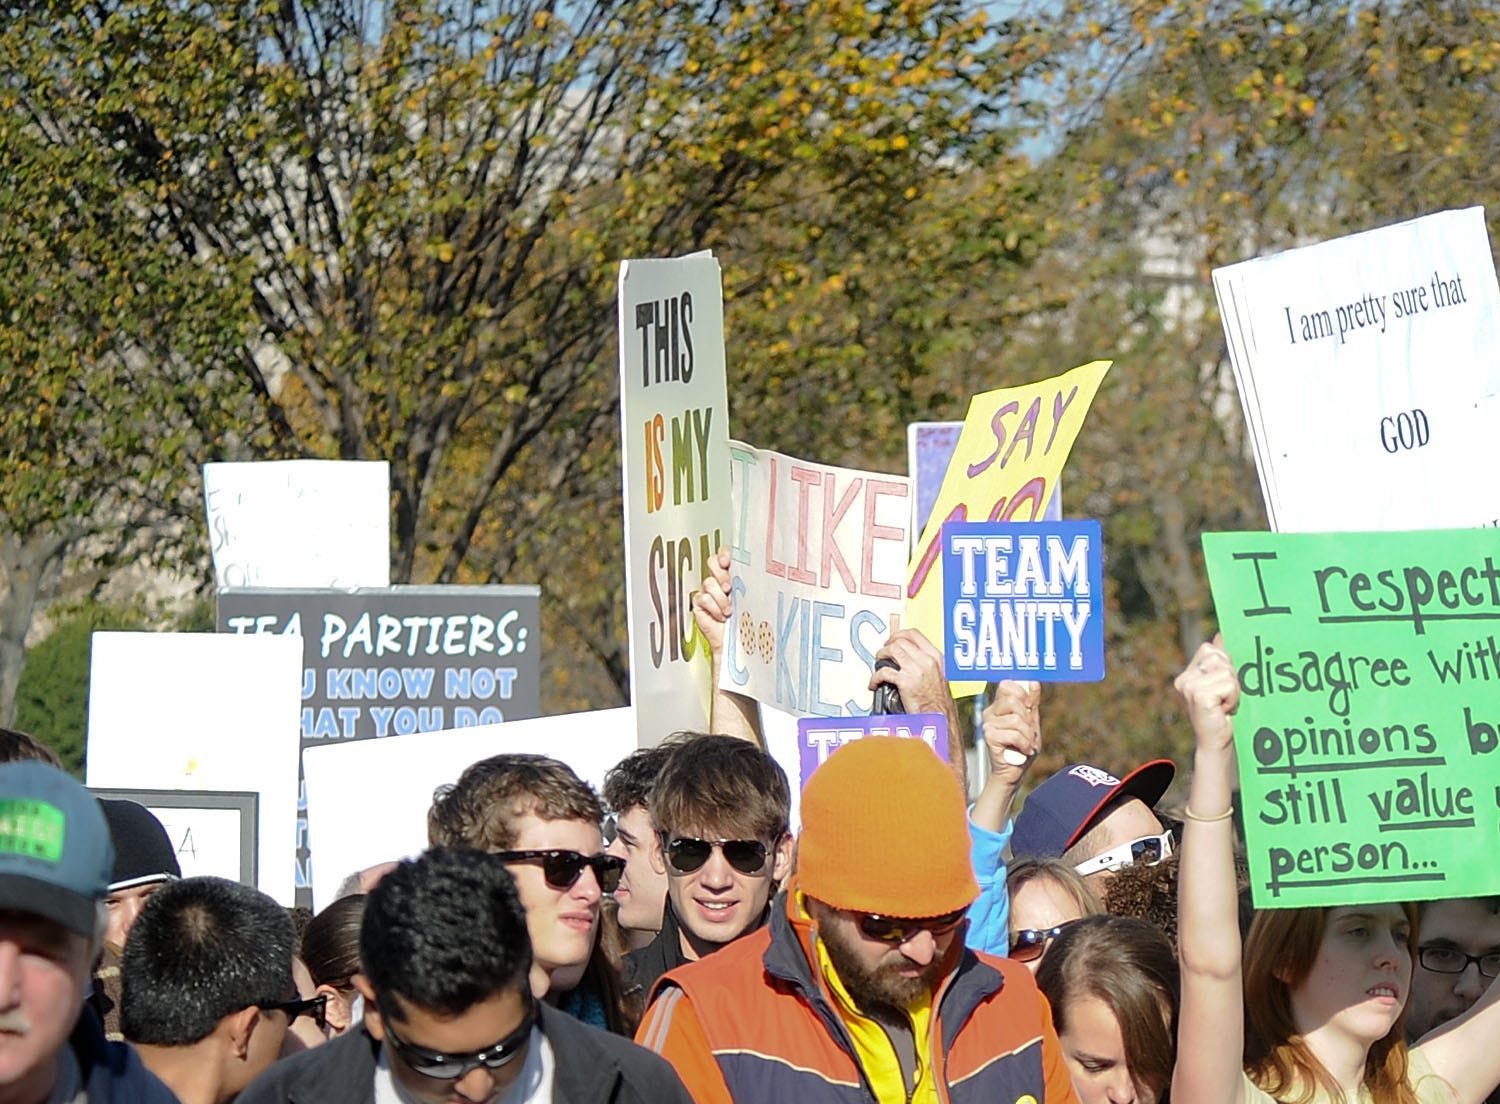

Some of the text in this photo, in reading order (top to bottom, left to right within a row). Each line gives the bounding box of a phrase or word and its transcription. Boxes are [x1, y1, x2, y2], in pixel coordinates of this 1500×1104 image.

[636, 291, 694, 387] THIS
[1284, 270, 1467, 344] I am pretty sure that
[644, 407, 713, 513] IS MY
[966, 385, 1079, 479] SAY
[1380, 408, 1430, 453] GOD
[731, 447, 909, 600] I LIKE
[951, 535, 1091, 598] TEAM
[1232, 551, 1292, 616] I
[321, 610, 528, 658] PARTIERS:
[952, 600, 1091, 671] SANITY
[326, 667, 436, 699] KNOW
[445, 667, 518, 699] NOT
[1238, 636, 1411, 716] disagree
[370, 707, 444, 738] YOU
[1253, 716, 1438, 779] opinions
[1260, 778, 1347, 826] still
[1368, 772, 1475, 823] value
[1269, 840, 1438, 897] person...
